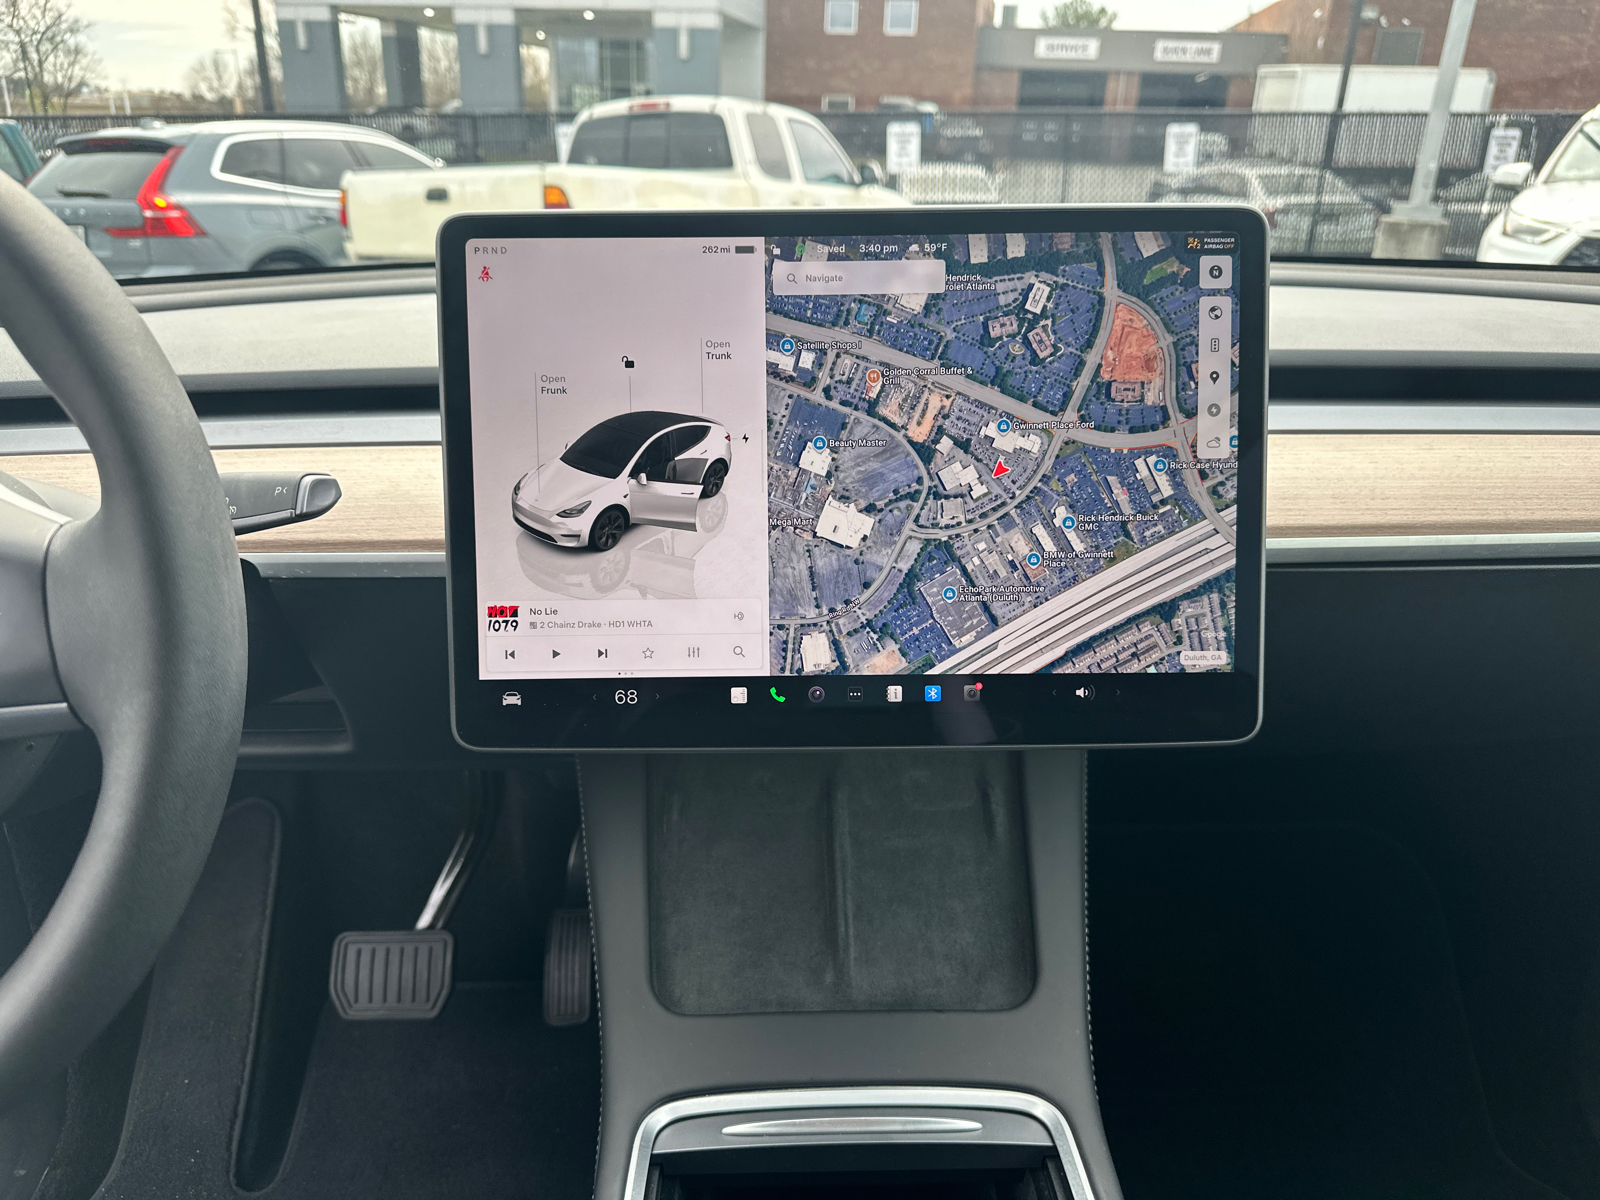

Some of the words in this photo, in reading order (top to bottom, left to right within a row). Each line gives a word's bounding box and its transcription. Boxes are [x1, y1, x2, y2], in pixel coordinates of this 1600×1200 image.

[702, 245, 719, 254] 262
[817, 244, 846, 253] Saved
[859, 244, 881, 253] 3:40
[883, 245, 898, 255] pm
[924, 243, 948, 252] 59°F
[805, 274, 843, 283] Navigate
[945, 273, 982, 282] Hendrick
[965, 282, 995, 291] Atlanta
[705, 339, 731, 350] Open
[797, 341, 830, 350] Satellite
[831, 341, 857, 352] Shops
[705, 351, 732, 360] Trunk
[883, 367, 911, 376] Golden
[913, 367, 938, 376] Corral
[940, 367, 965, 376] Buffet
[966, 367, 973, 375] &
[540, 374, 566, 384] Open
[883, 376, 900, 385] Grill
[540, 386, 568, 395] Frunk
[1013, 421, 1050, 430] Gwinnett
[1051, 421, 1074, 430] Place
[1075, 420, 1095, 429] Ford
[829, 439, 857, 449] Beauty
[858, 438, 887, 448] Master
[1170, 461, 1188, 470] Rick
[1189, 461, 1210, 470] Case
[769, 518, 792, 527] Mega
[793, 517, 813, 526] Mart
[1078, 513, 1097, 522] Rick
[1098, 513, 1135, 522] Hendrick
[1136, 513, 1159, 522] Buick
[1078, 523, 1099, 531] GMC
[1043, 551, 1065, 559] BMW
[1067, 551, 1076, 559] of
[1078, 550, 1114, 559] Gwinnett
[1043, 559, 1066, 568] Place
[959, 586, 996, 595] EchoPark
[998, 584, 1045, 593] Automotive
[958, 594, 988, 602] Atlanta
[989, 593, 1022, 602] (Duluth)
[487, 604, 520, 619] HOT
[529, 607, 542, 616] No
[544, 607, 558, 616] Lie
[828, 609, 842, 619] Ring
[539, 621, 546, 629] 2
[547, 620, 576, 629] Chainz
[578, 620, 602, 629] Drake
[608, 619, 625, 629] HD1
[626, 619, 653, 628] WHTA
[1184, 654, 1209, 663] Duluth,
[1211, 653, 1222, 662] GA
[614, 689, 639, 705] 68
